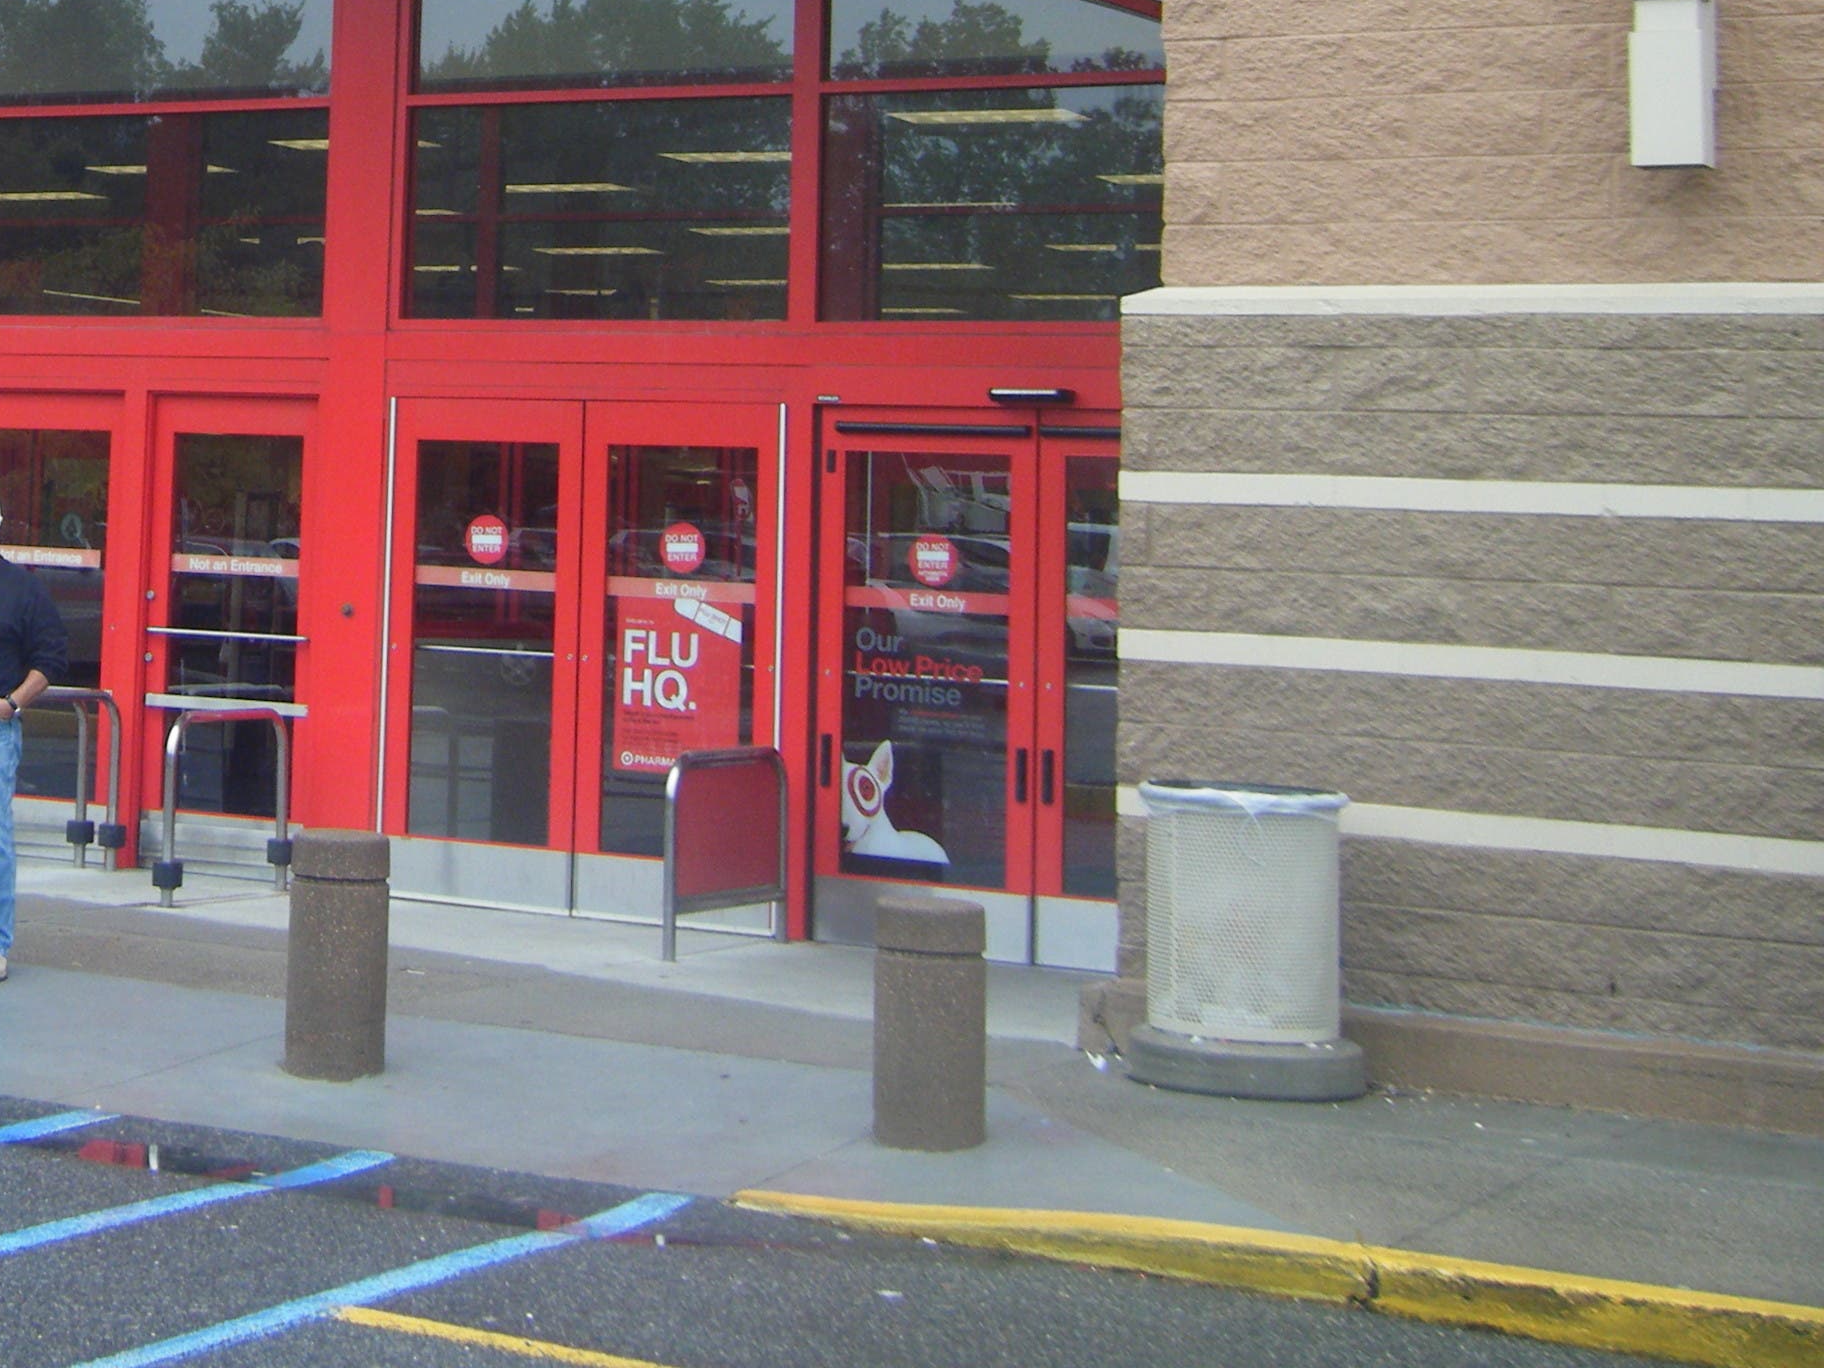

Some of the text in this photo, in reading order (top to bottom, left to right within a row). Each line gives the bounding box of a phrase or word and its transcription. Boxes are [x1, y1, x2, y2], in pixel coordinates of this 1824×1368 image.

[471, 526, 502, 535] DO NOT
[665, 535, 698, 544] DO NOT
[916, 542, 949, 551] DO NOT
[472, 544, 501, 553] ENTER
[17, 552, 31, 563] an
[33, 550, 82, 565] Entrance
[667, 552, 697, 562] ENTER
[918, 561, 948, 569] ENTER
[189, 558, 282, 574] Not an Entrance
[461, 571, 510, 587] Exit Only
[656, 582, 707, 599] Exit Only
[910, 593, 965, 611] Exit Only
[855, 626, 904, 652] Our
[623, 628, 699, 668] FLU
[855, 652, 984, 681] Low Price
[622, 666, 698, 712] HQ.
[854, 675, 962, 707] Promise
[634, 753, 677, 766] PHARMA
